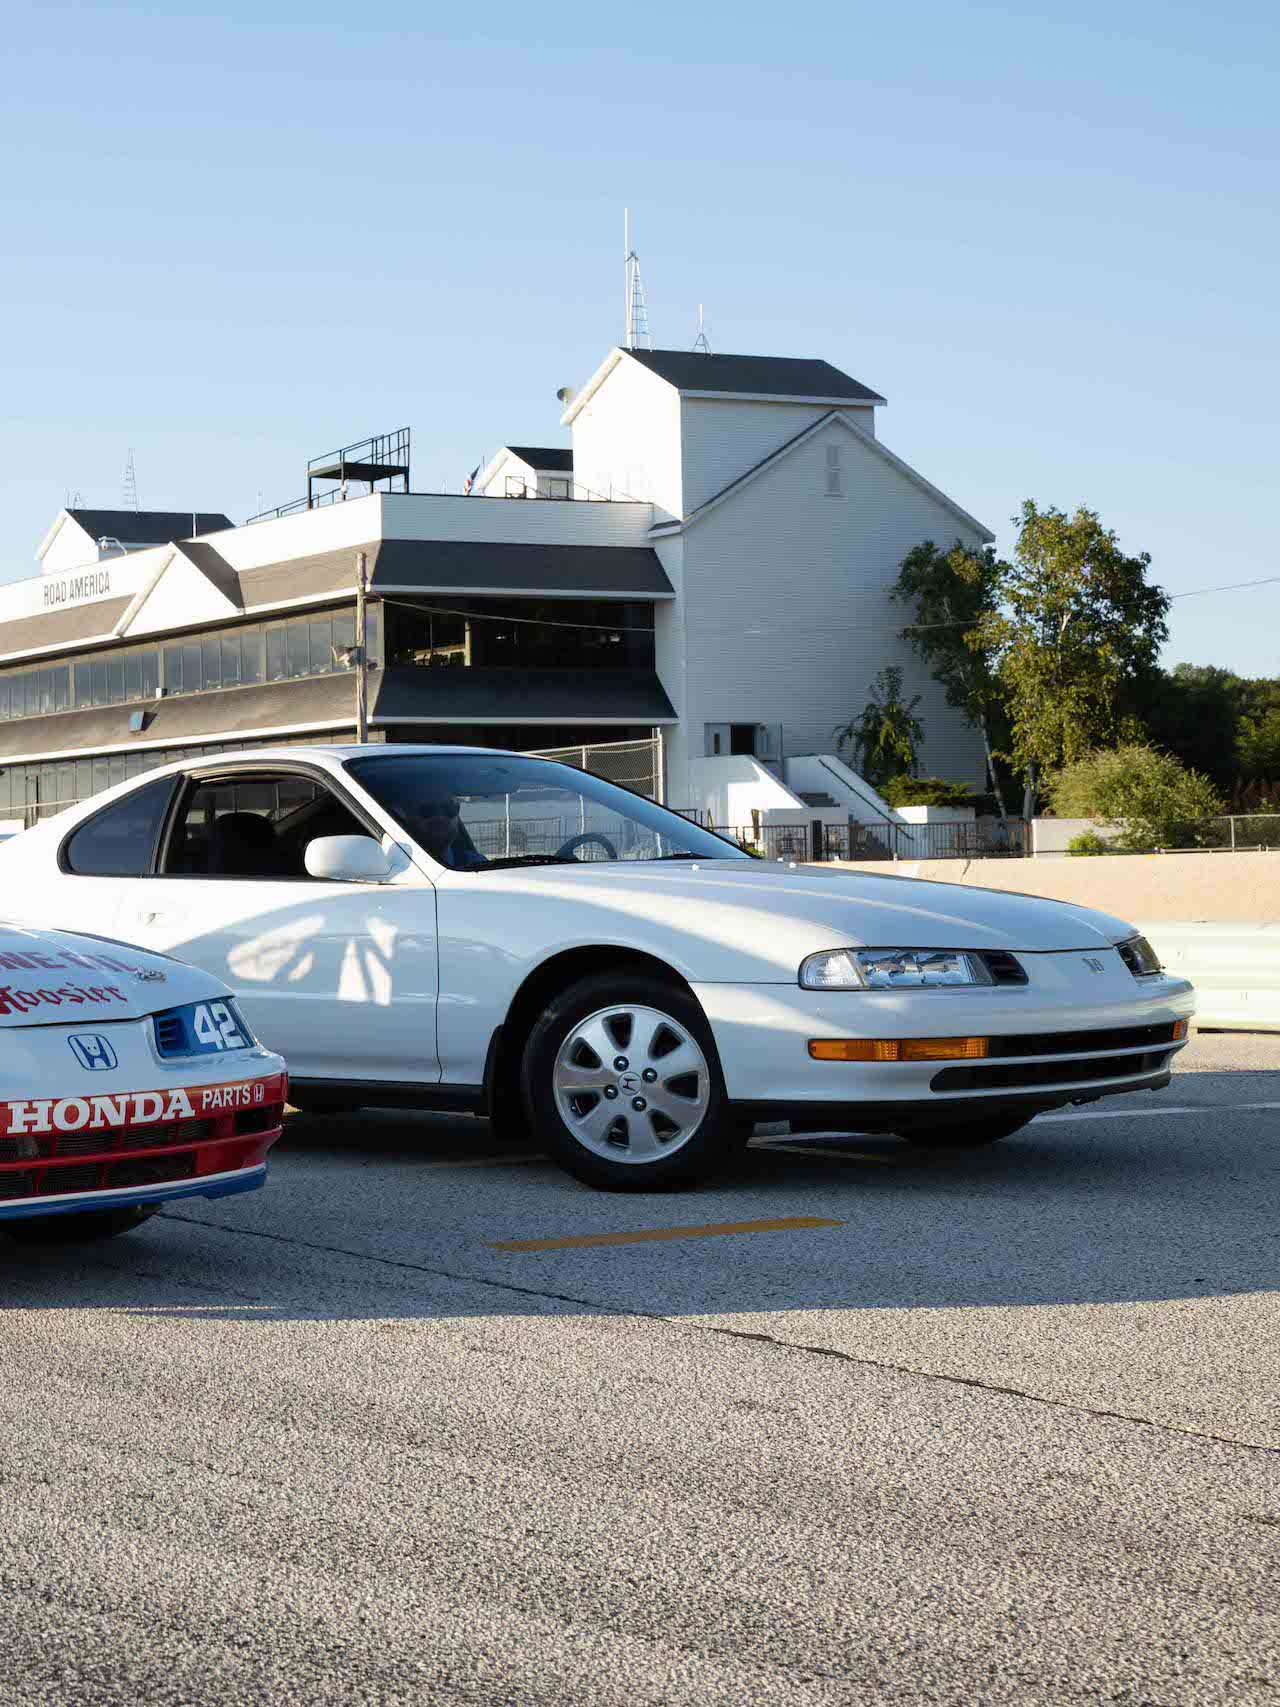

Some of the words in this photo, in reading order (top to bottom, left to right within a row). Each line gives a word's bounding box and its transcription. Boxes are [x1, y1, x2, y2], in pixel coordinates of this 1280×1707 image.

[43, 581, 66, 606] ROAD
[69, 571, 110, 600] AMERICA
[194, 1003, 244, 1050] 42
[7, 1089, 195, 1134] HONDA
[202, 1085, 251, 1110] PARTS
